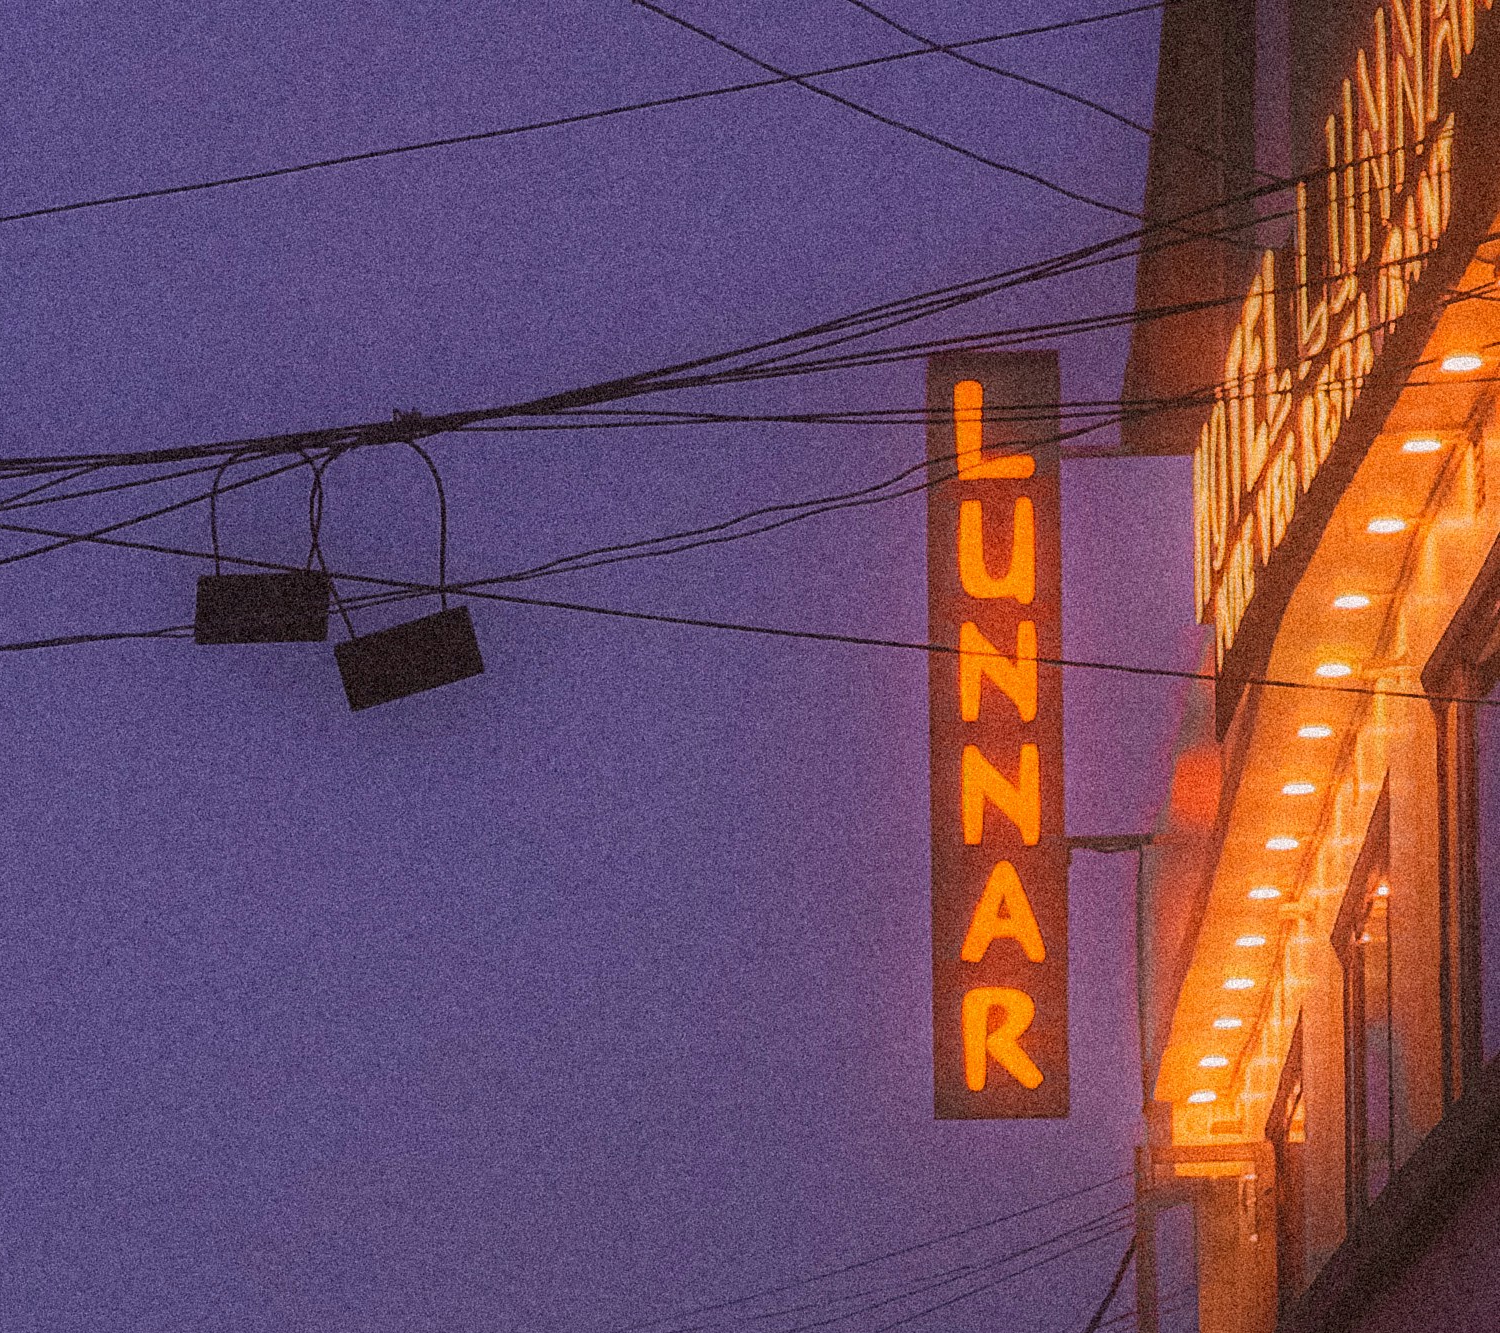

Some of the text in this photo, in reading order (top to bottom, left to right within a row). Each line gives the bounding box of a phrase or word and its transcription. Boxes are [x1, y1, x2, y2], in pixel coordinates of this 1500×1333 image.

[1193, 0, 1492, 624] HOTEL LUNNA
[1258, 431, 1296, 566] VEG
[1300, 112, 1454, 493] RESTAURANT
[953, 380, 1045, 1091] LUNNAR
